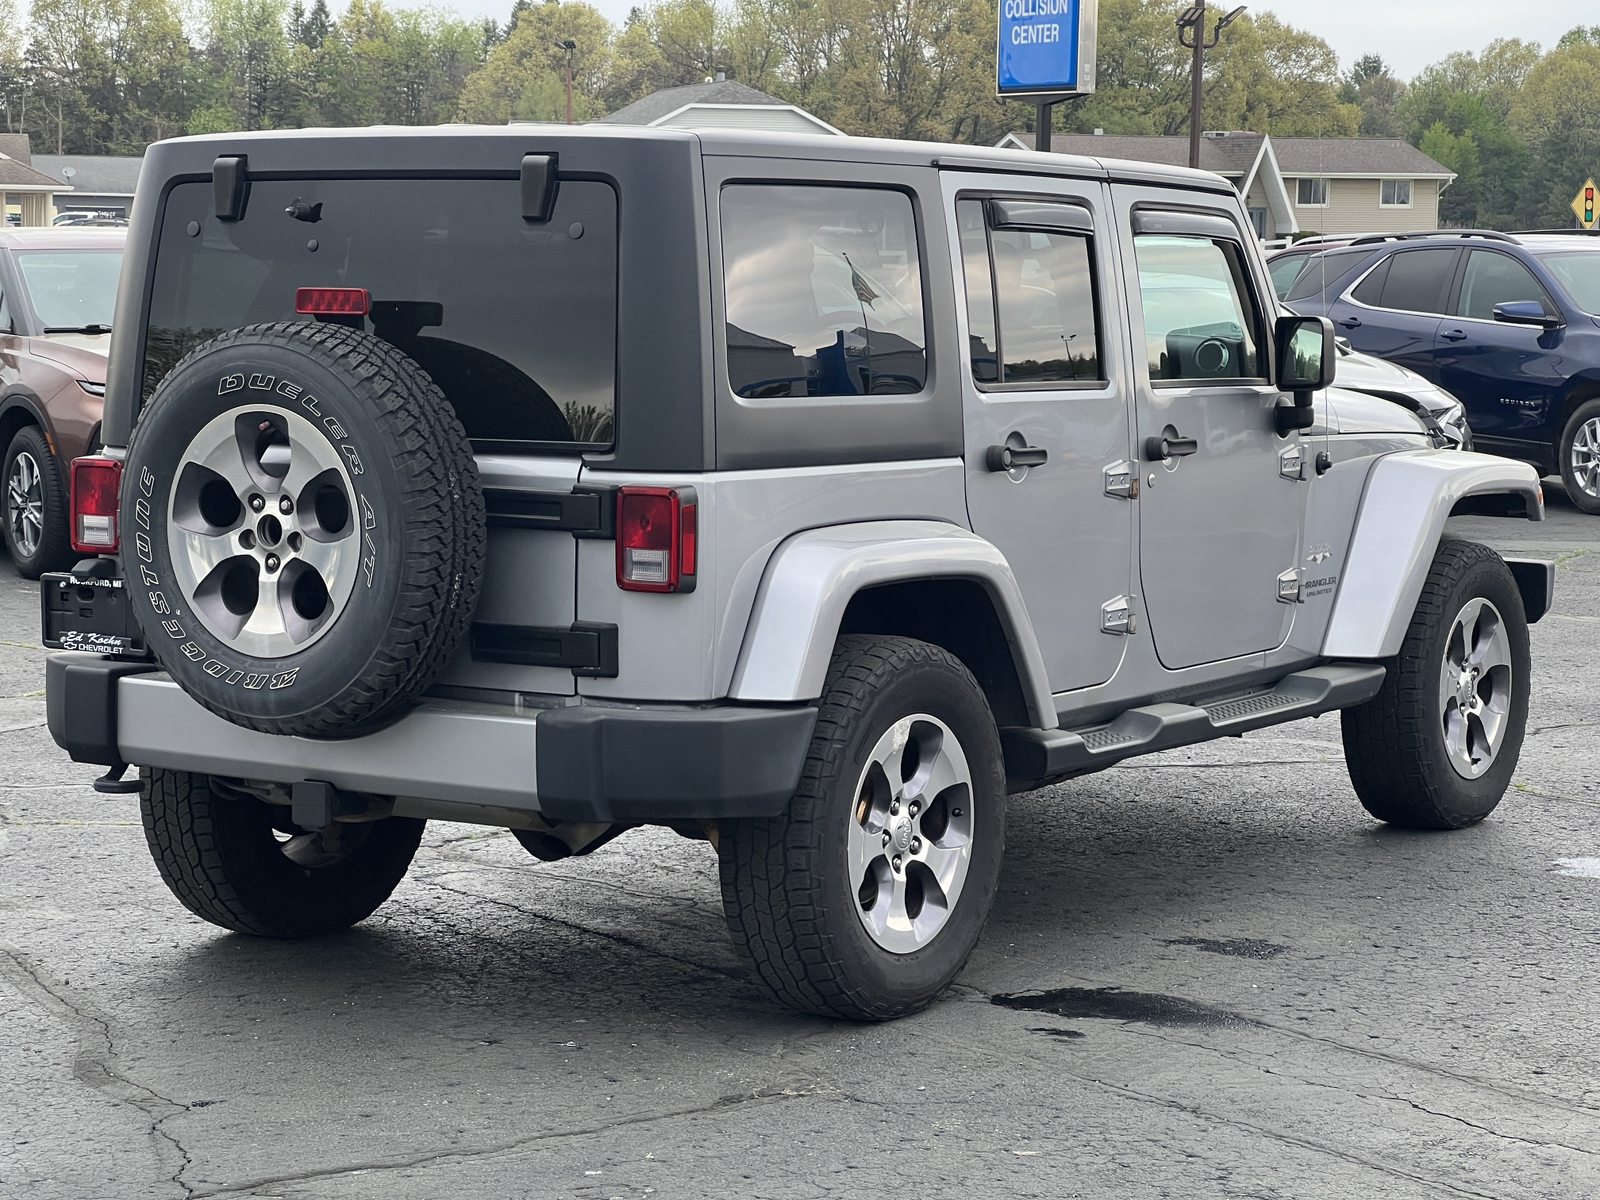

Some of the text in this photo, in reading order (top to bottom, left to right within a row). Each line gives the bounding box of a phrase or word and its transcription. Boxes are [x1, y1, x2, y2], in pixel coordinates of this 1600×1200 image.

[1005, 0, 1068, 18] COLLISION
[1012, 24, 1059, 45] CENTER
[217, 373, 364, 475] DUELER
[112, 580, 122, 588] MI
[136, 466, 300, 690] BRIDGESTONE
[1306, 588, 1332, 597] UNLIMITED
[66, 631, 122, 646] Ed Koehn
[78, 644, 123, 654] CHEVROLET
